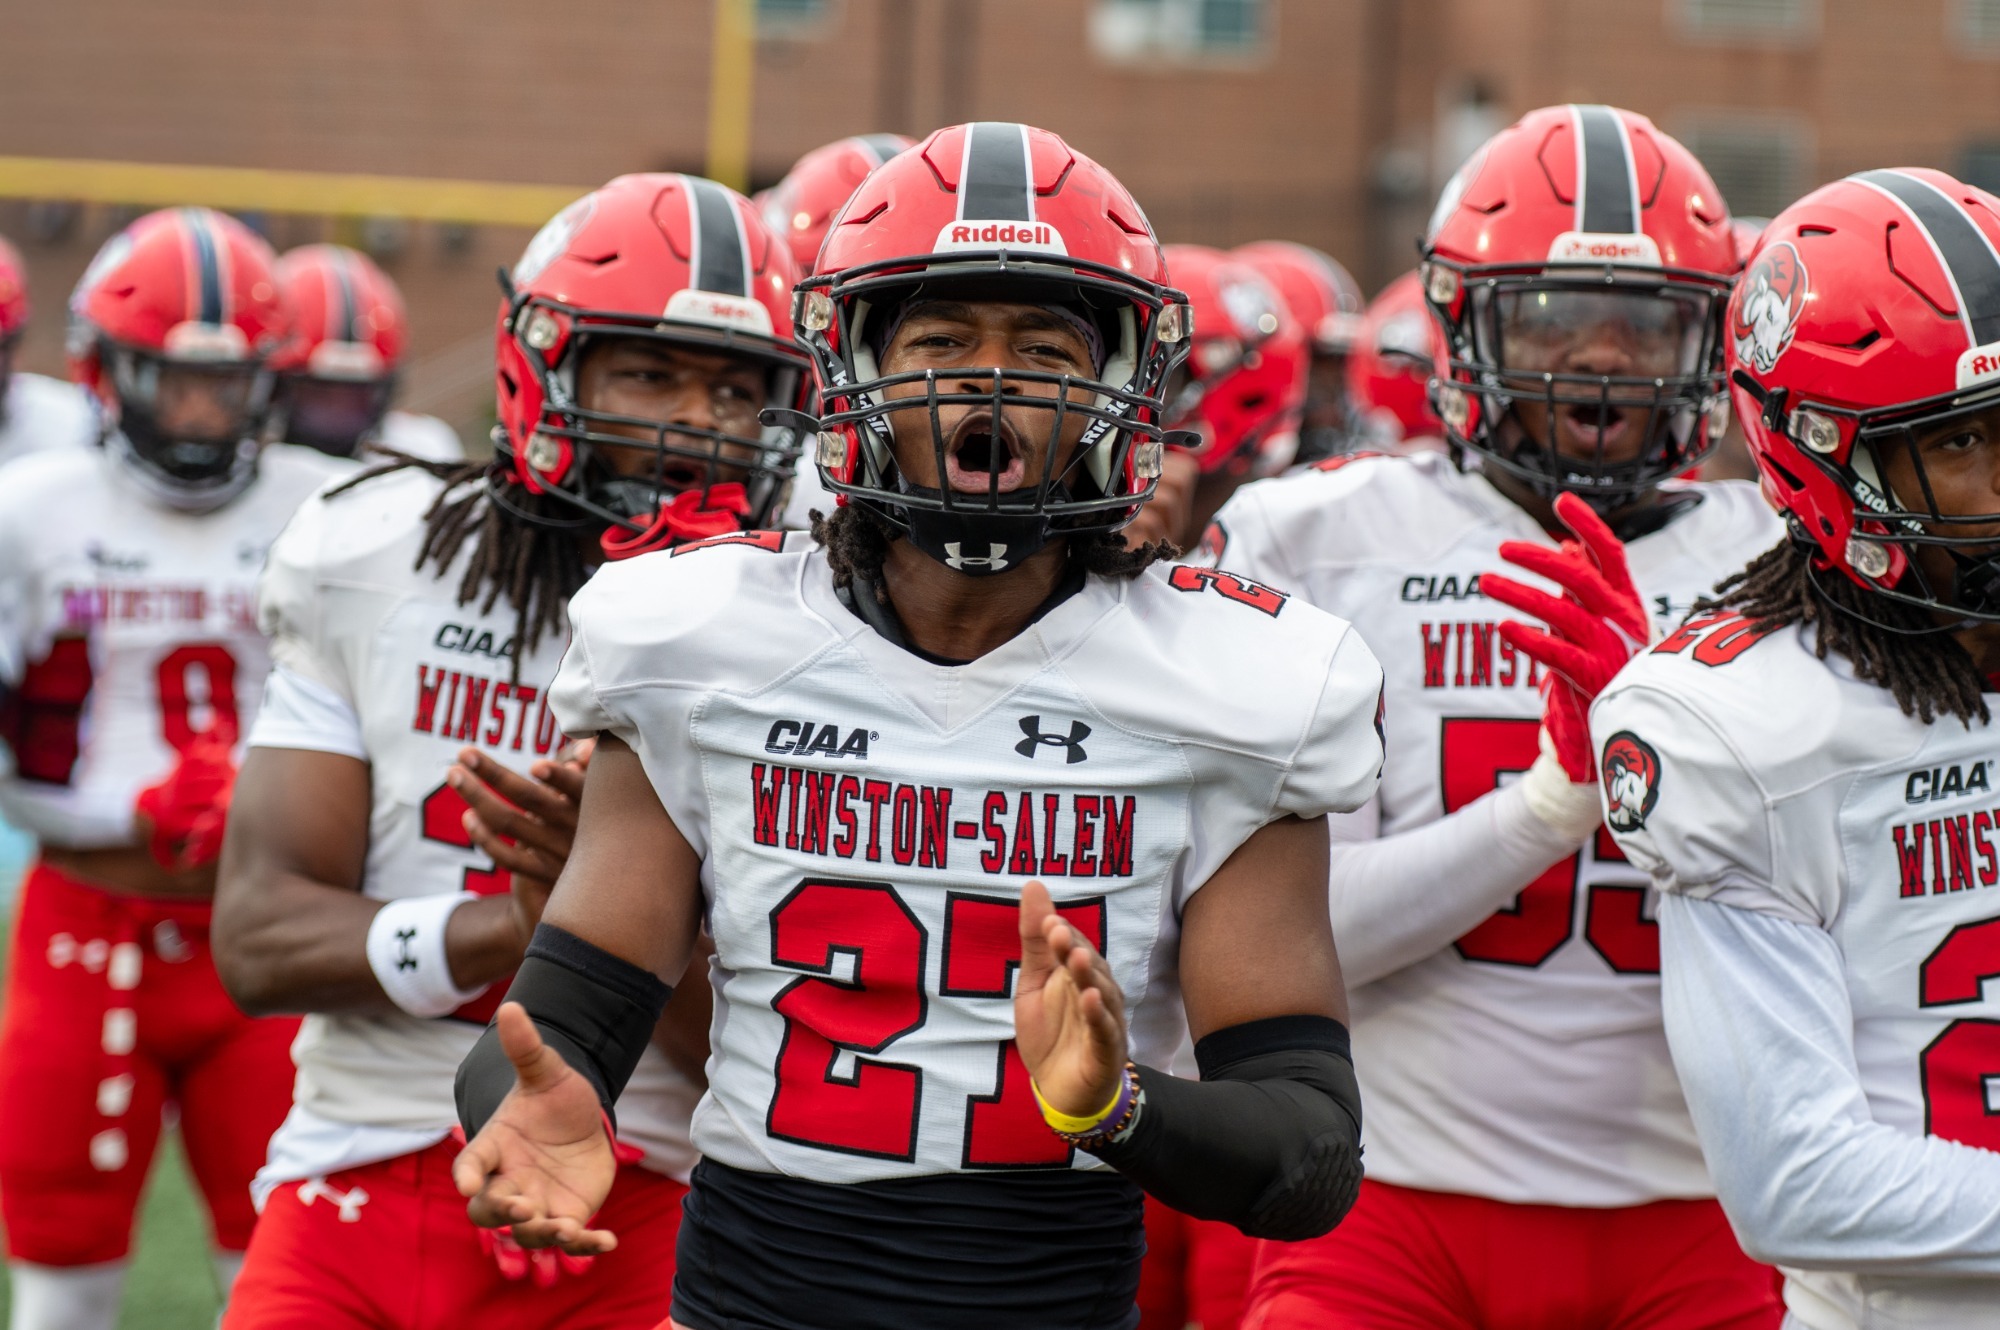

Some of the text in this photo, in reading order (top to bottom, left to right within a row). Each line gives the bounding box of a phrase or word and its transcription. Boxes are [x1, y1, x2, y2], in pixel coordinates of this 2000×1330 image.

[952, 224, 1050, 244] Riddell
[1972, 354, 2000, 375] Ri
[413, 664, 567, 755] WINSTO
[751, 762, 1137, 877] WINSTON-SALEM
[1893, 808, 2000, 898] WINS
[766, 877, 1107, 1170] 27
